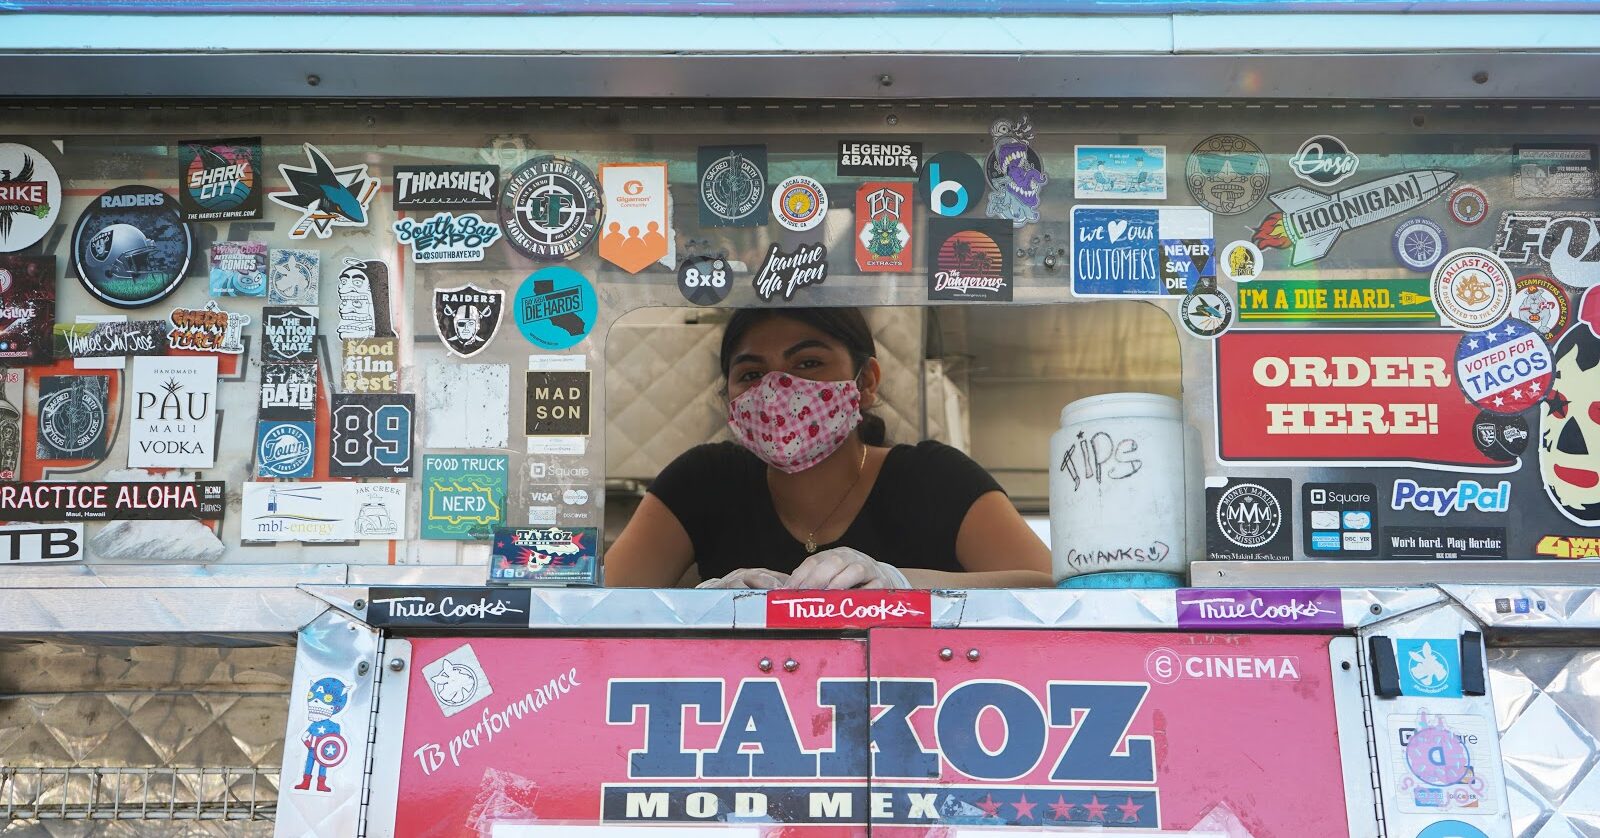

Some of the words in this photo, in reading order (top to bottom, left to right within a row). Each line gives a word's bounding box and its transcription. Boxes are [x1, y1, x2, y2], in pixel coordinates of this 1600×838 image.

[842, 144, 911, 155] LEGENDS
[191, 162, 248, 189] SHARK
[706, 161, 728, 180] SACRED
[741, 162, 758, 178] OATH
[199, 177, 241, 200] CITY
[396, 170, 495, 201] THRASHER
[506, 165, 538, 198] LOKEY
[541, 163, 596, 199] FIREARMS
[101, 193, 164, 208] RAIDERS
[705, 189, 726, 214] TATTOOS
[739, 202, 753, 214] SAN
[396, 216, 456, 241] South
[457, 216, 498, 243] Bay
[506, 218, 546, 255] MORGAN
[579, 223, 594, 238] CA
[415, 234, 482, 251] EXPO
[1164, 244, 1210, 256] NEVER
[221, 260, 257, 270] COMICS
[1078, 247, 1156, 281] CUSTOMERS
[1166, 262, 1191, 273] SAY
[1443, 259, 1481, 284] BALLAST
[1481, 262, 1504, 287] POINT
[685, 269, 726, 288] 8x8
[934, 271, 1007, 293] Dangerous
[1166, 278, 1188, 289] DIE
[1517, 279, 1560, 296] STEAMFITTERS
[442, 294, 496, 304] RAIDERS
[526, 303, 543, 321] DIE
[543, 294, 580, 316] HARDS
[1240, 289, 1268, 308] I'M
[1274, 289, 1288, 308] A
[1294, 289, 1328, 309] DIE
[1334, 289, 1395, 309] HARD.
[1442, 291, 1468, 319] DEDICATED
[1480, 310, 1491, 319] THE
[0, 307, 36, 319] GLIVE
[281, 318, 301, 326] THE
[265, 326, 317, 336] NATION
[269, 335, 284, 343] YA
[286, 335, 313, 343] LOVE
[346, 341, 394, 356] food
[1465, 350, 1506, 373] VOTED
[1509, 339, 1535, 357] FOR
[345, 355, 393, 372] film
[1252, 356, 1451, 388] ORDER
[1466, 351, 1547, 394] TACOS
[266, 373, 311, 383] STAY
[343, 373, 392, 391] fest
[535, 388, 581, 400] MAD
[136, 388, 210, 420] PAU
[536, 406, 581, 419] SON
[1266, 403, 1440, 435] HERE!
[332, 405, 412, 467] 89
[140, 441, 204, 454] VODKA
[266, 438, 305, 460] Town
[427, 458, 459, 471] FOOD
[462, 458, 505, 471] TRUCK
[548, 465, 589, 479] Square
[0, 485, 108, 509] RACTICE
[115, 485, 198, 509] ALOHA
[373, 485, 401, 495] CREEK
[531, 492, 554, 501] VISA
[1223, 487, 1249, 506] MONEY
[1251, 487, 1275, 506] MAKIN
[1328, 491, 1370, 504] Square
[1394, 482, 1508, 513] PayPal
[443, 496, 486, 512] NERD
[1228, 503, 1271, 524] MMM
[1234, 535, 1266, 544] MISSION
[1391, 537, 1415, 548] Work
[1418, 536, 1443, 548] hard.
[1447, 537, 1466, 550] Play
[1538, 536, 1569, 558] 4
[1185, 656, 1298, 679] CINEMA
[414, 743, 446, 776] TB
[449, 667, 582, 767] performance
[606, 677, 1157, 783] TAKOZ
[625, 792, 768, 818] MOD
[809, 792, 941, 819] MEX
